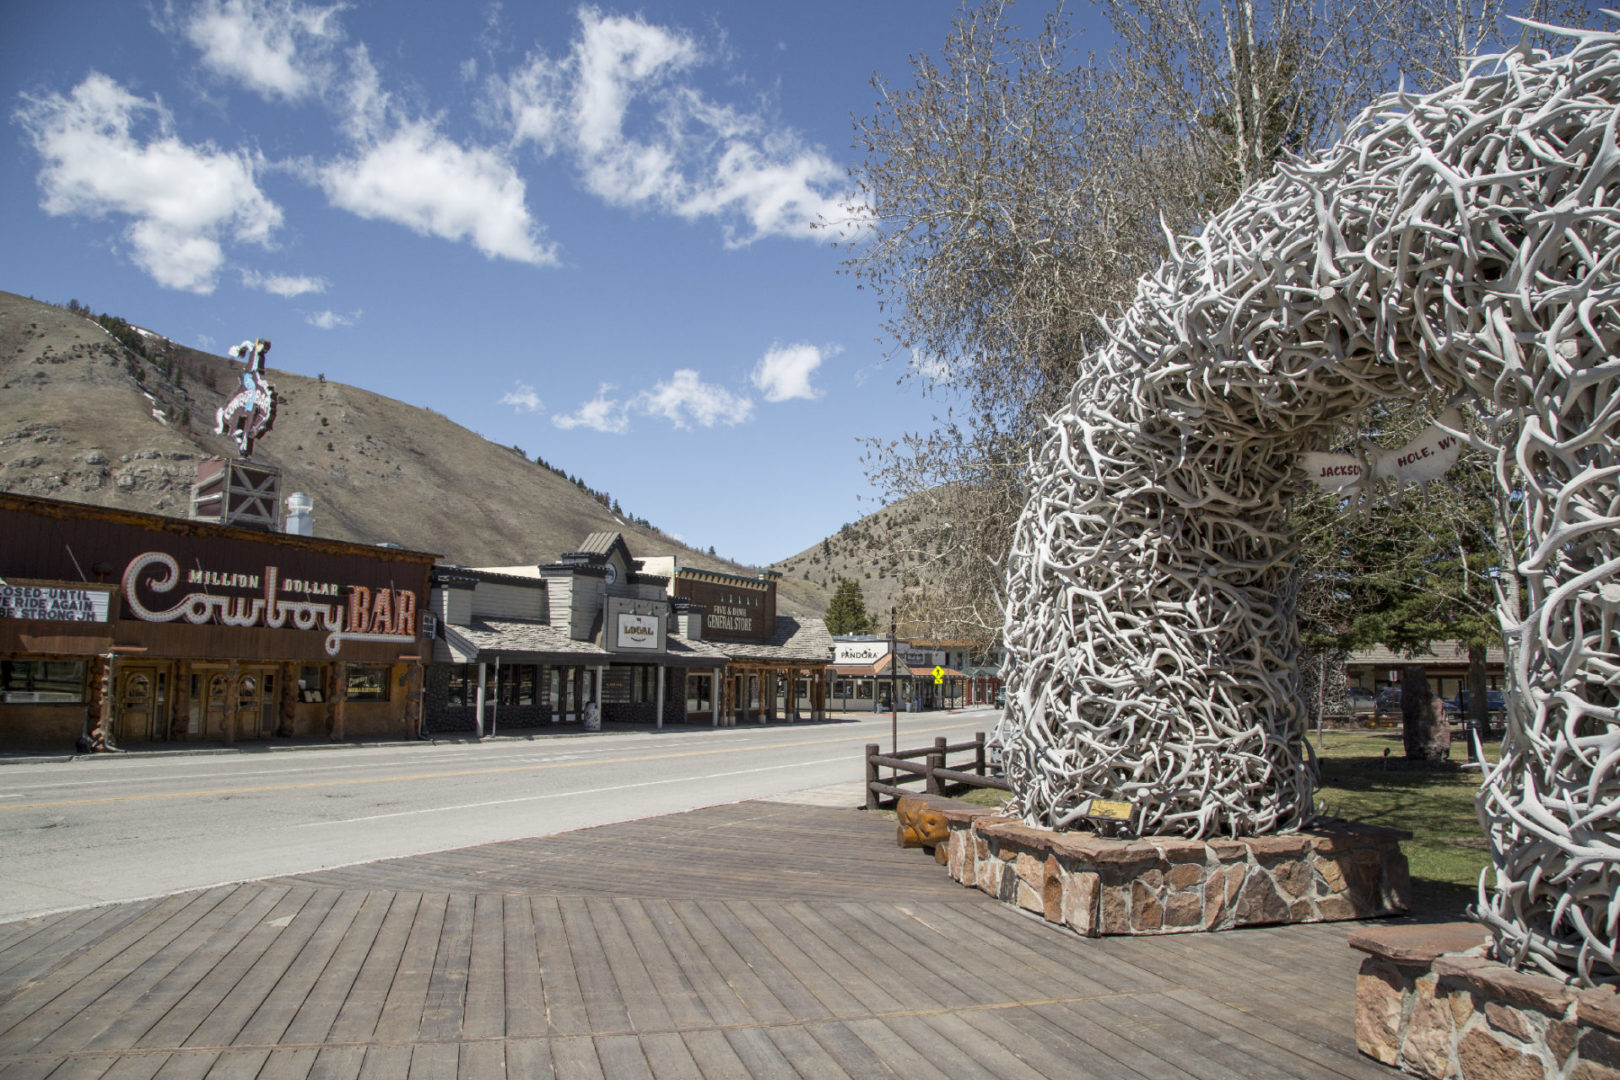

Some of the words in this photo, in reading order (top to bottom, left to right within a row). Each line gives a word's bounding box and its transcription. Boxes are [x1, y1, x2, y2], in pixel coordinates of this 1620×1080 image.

[1320, 465, 1362, 477] JACKSO
[188, 569, 259, 588] MILLION
[283, 578, 339, 596] DOLLAR
[15, 598, 47, 608] RIDE
[51, 600, 93, 611] AGAIN
[122, 551, 345, 656] Cowboy
[346, 585, 416, 634] BAR
[21, 609, 74, 620] STRONG
[708, 614, 733, 629] GENERAL
[734, 617, 752, 631] STORE
[624, 625, 654, 636] LOCAL
[840, 650, 879, 659] PANDORA
